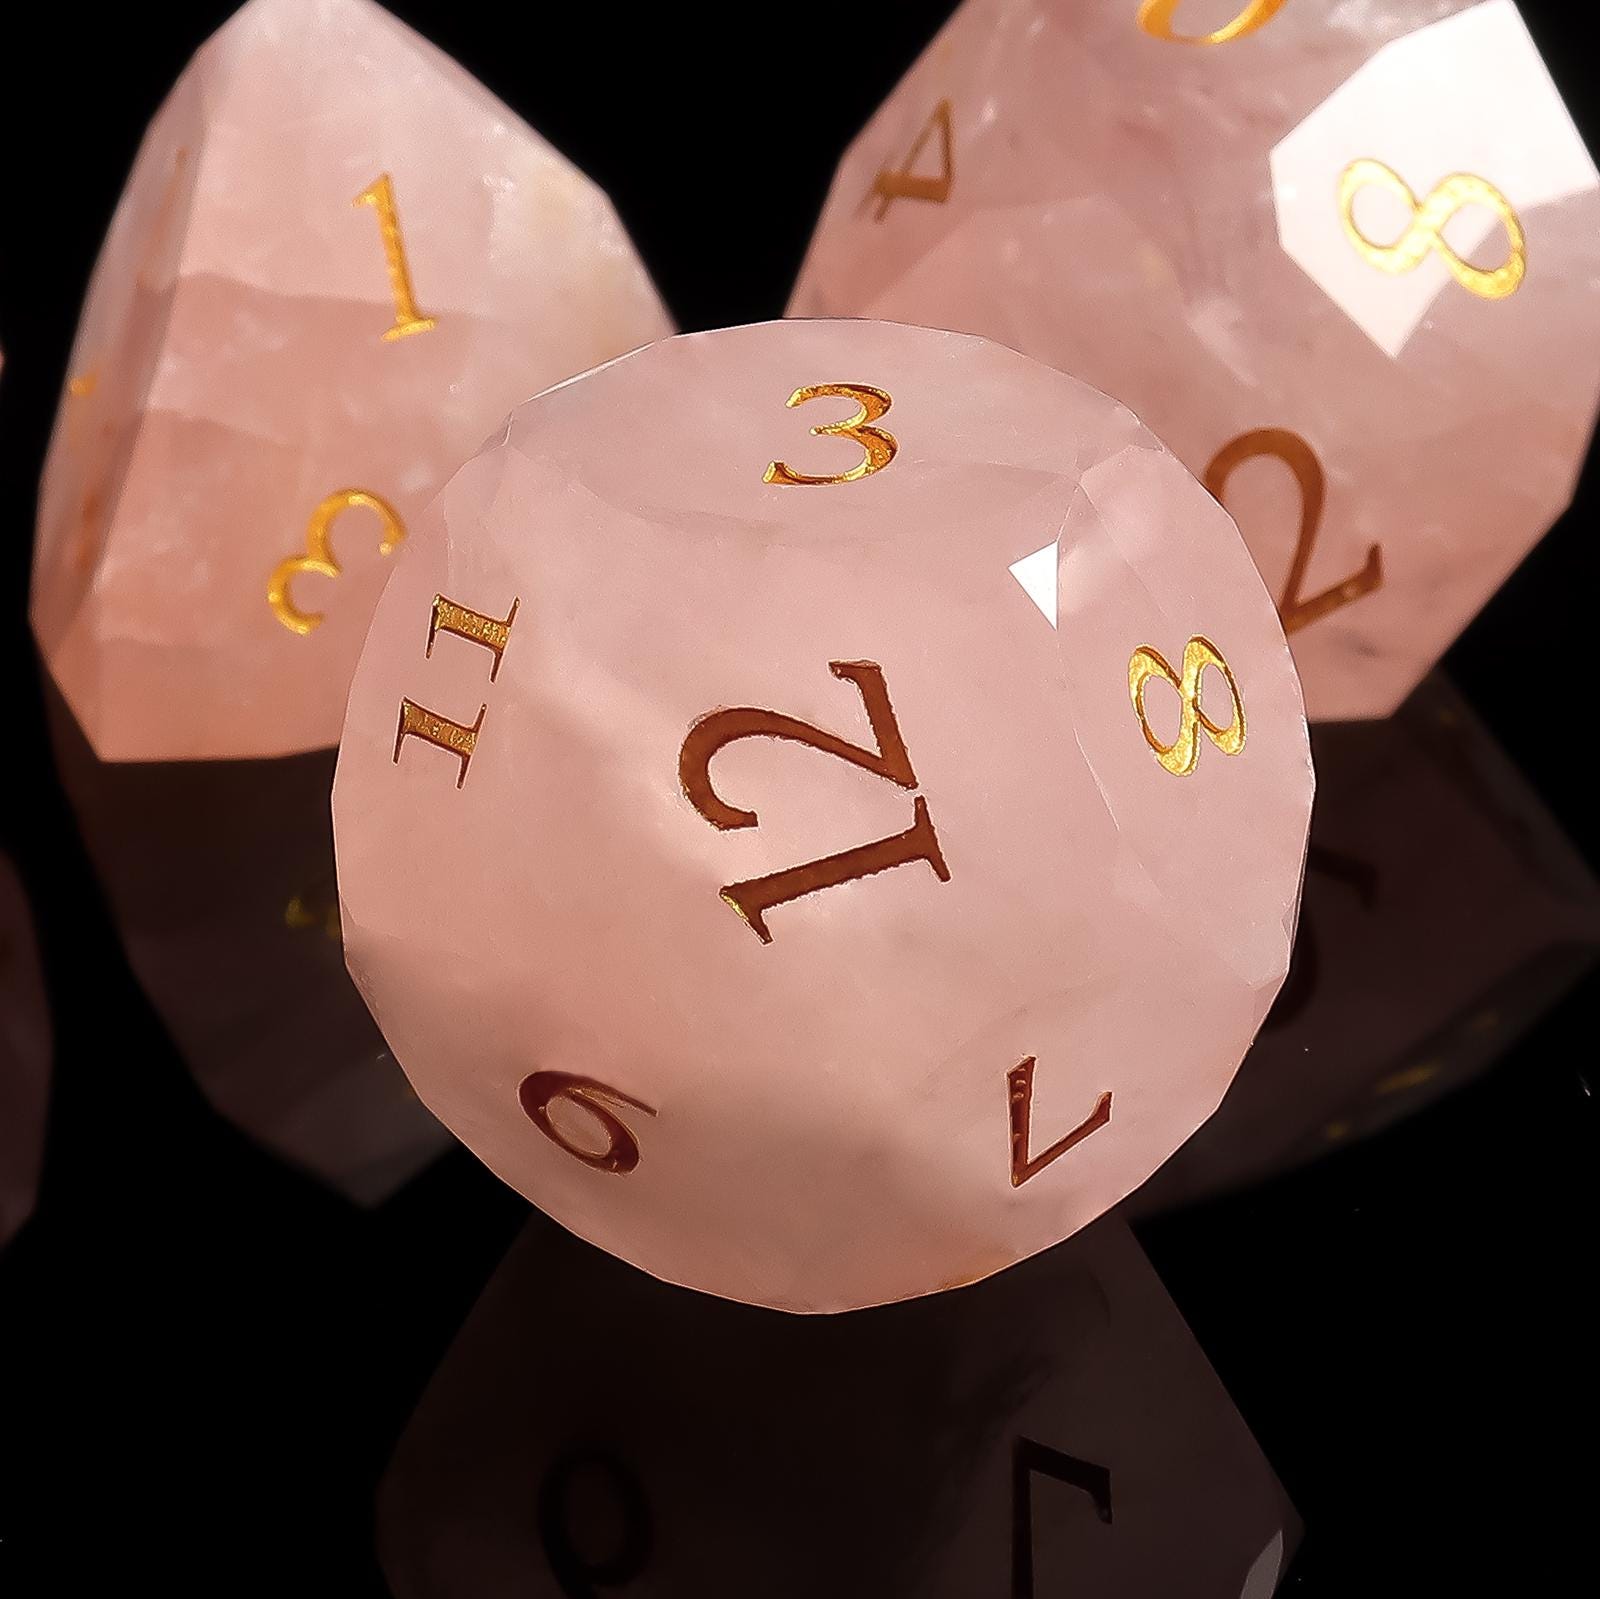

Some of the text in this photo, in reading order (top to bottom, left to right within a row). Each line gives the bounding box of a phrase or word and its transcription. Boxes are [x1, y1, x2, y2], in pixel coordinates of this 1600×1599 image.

[353, 173, 437, 342] 1
[1337, 157, 1526, 299] 8
[762, 382, 899, 487] 3
[268, 489, 405, 635] 3
[1205, 427, 1382, 635] 2
[392, 593, 520, 790] 11
[1128, 633, 1247, 777] 8
[679, 658, 951, 945] 12
[1006, 1054, 1113, 1189] 7
